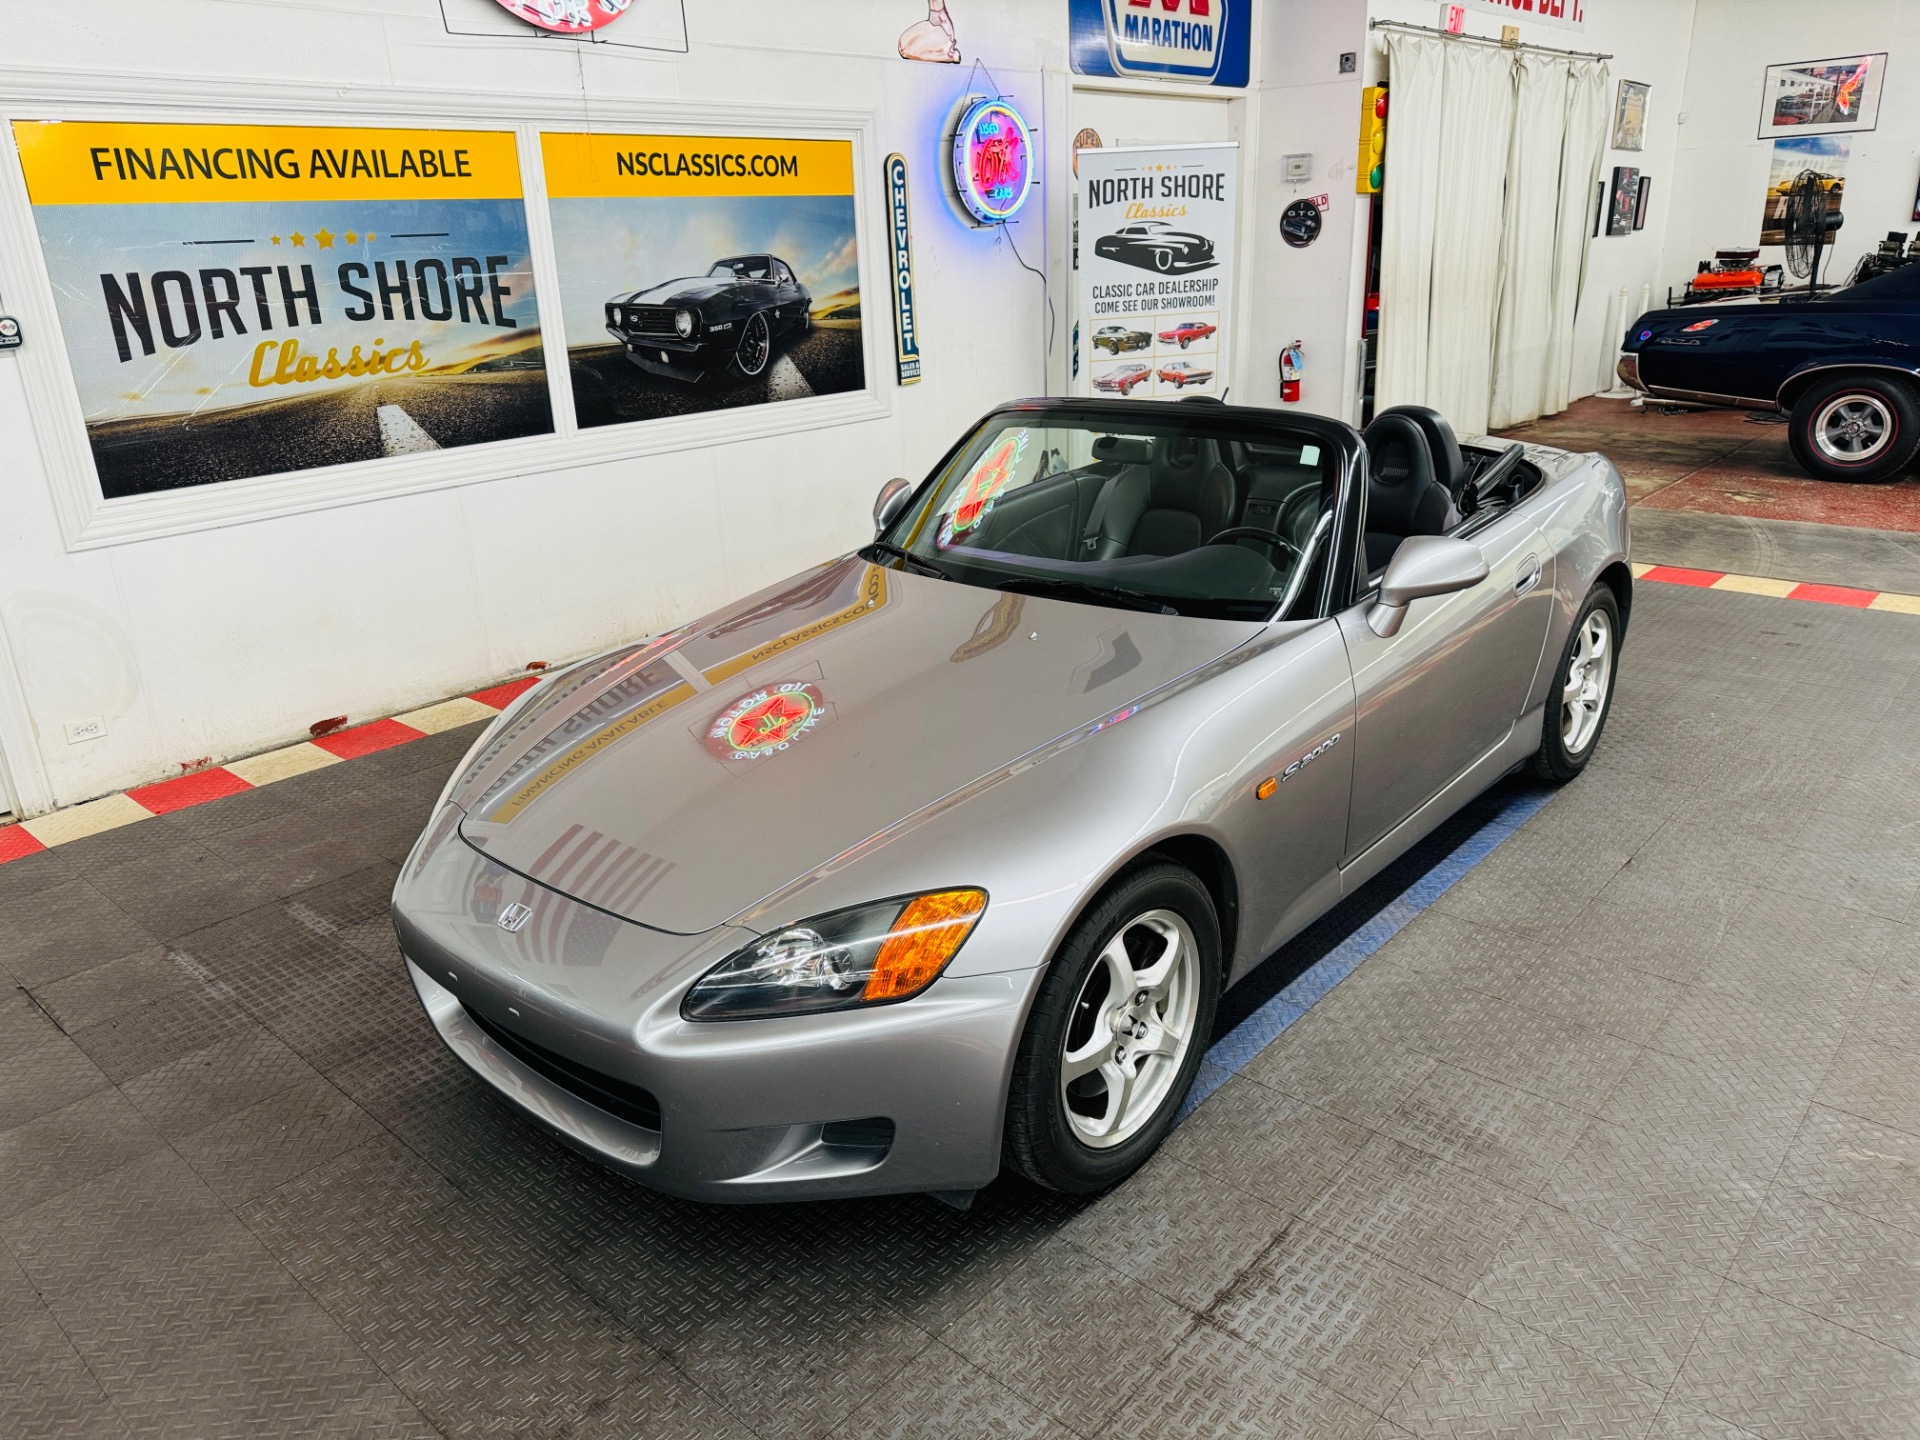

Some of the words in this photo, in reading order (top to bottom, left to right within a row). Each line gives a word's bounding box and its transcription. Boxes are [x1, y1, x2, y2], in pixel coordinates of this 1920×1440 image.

[1124, 13, 1213, 52] MARATHON
[1449, 5, 1465, 33] EXIT
[89, 147, 301, 181] FINANCING
[308, 148, 473, 179] AVAILABLE
[616, 151, 799, 177] NSCLASSICS.COM
[979, 127, 1019, 189] OK
[1089, 176, 1154, 209] NORTH
[1161, 173, 1225, 202] SHORE
[1125, 202, 1188, 220] Classics
[892, 165, 913, 350] CHEVROLET
[1092, 283, 1133, 299] CLASSIC
[1135, 282, 1155, 297] CAR
[1158, 278, 1219, 295] DEALERSHIP
[1094, 301, 1120, 314] COME
[1122, 300, 1138, 312] SEE
[1141, 299, 1159, 311] OUR
[1161, 295, 1215, 310] SHOWROOM!
[100, 264, 321, 363] NORTH
[338, 255, 517, 329] SHORE
[247, 338, 430, 388] Classics
